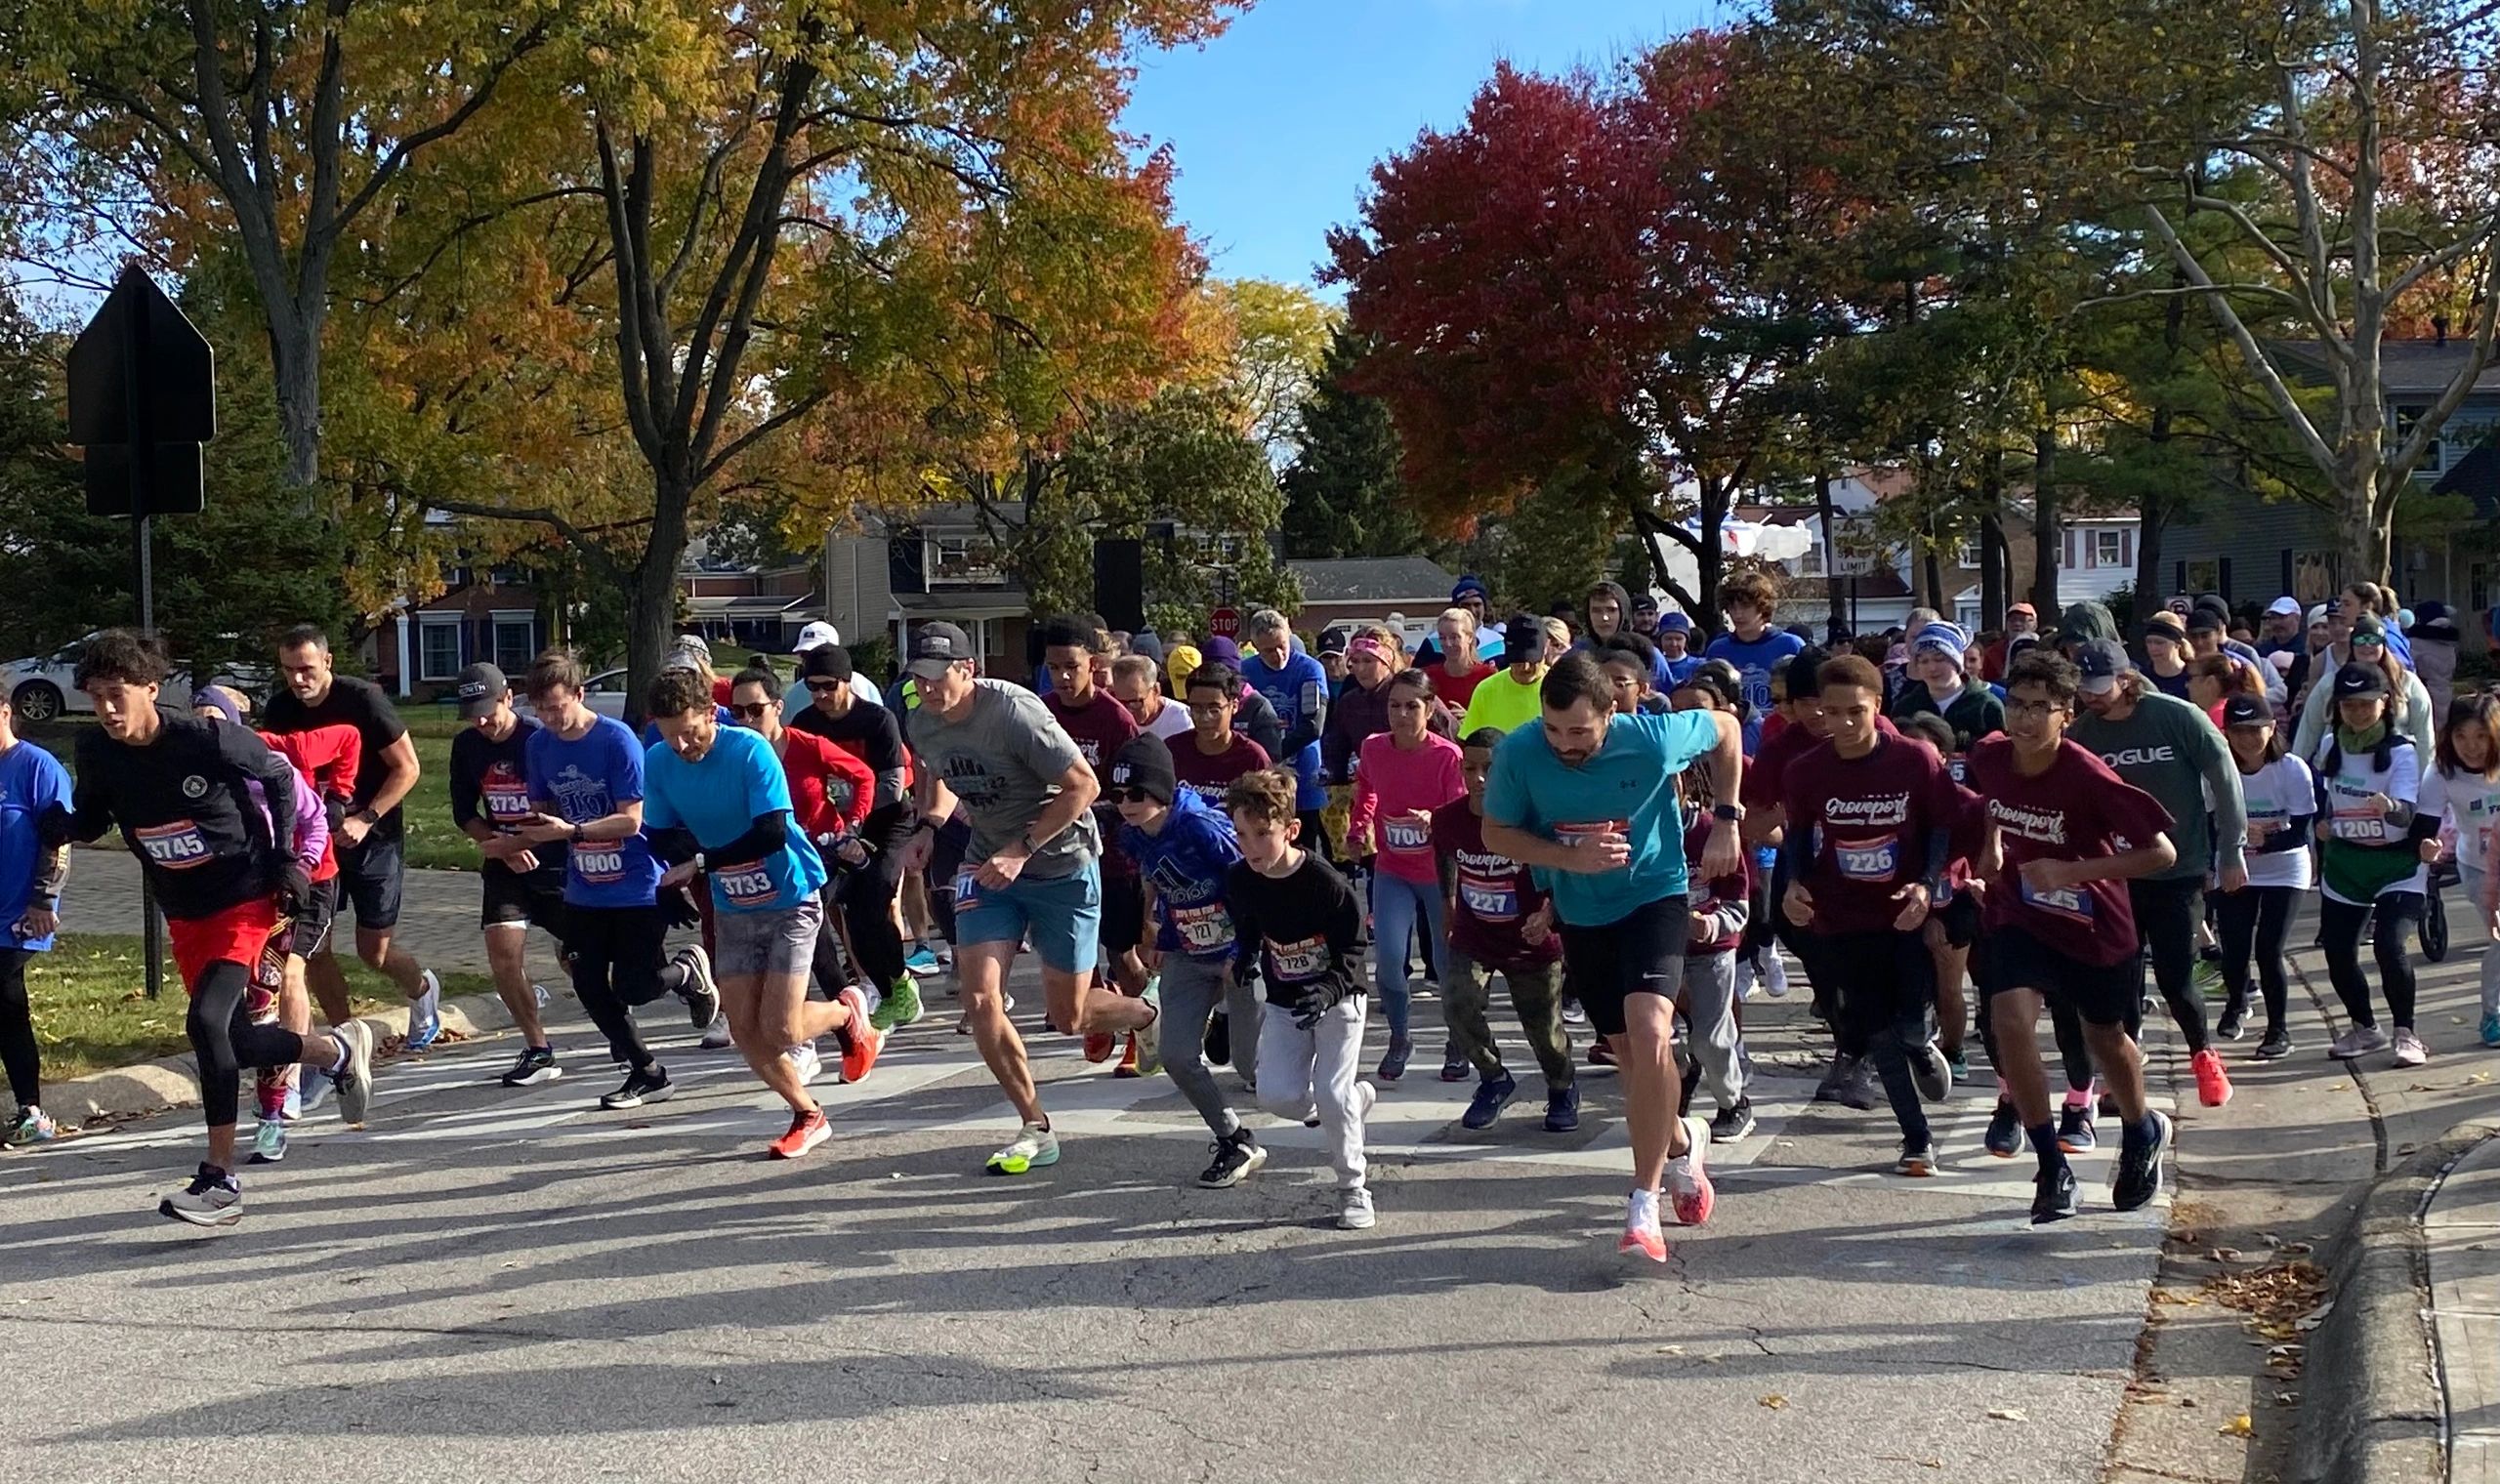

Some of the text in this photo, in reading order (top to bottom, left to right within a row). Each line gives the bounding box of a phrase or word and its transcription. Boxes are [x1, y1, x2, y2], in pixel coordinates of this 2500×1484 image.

[1840, 562, 1866, 571] LIMIT
[1211, 619, 1238, 631] STOP
[2104, 746, 2175, 768] OGUE
[488, 795, 530, 812] 3734
[1825, 791, 1909, 823] Groveport
[1989, 799, 2065, 835] Groveport
[1385, 825, 1427, 845] 1700
[2332, 820, 2382, 839] 1206
[146, 834, 204, 859] 3745
[574, 853, 622, 873] 1900
[1846, 849, 1893, 872] 226
[720, 872, 771, 896] 3733
[1469, 890, 1507, 913] 227
[1284, 955, 1309, 969] 728
